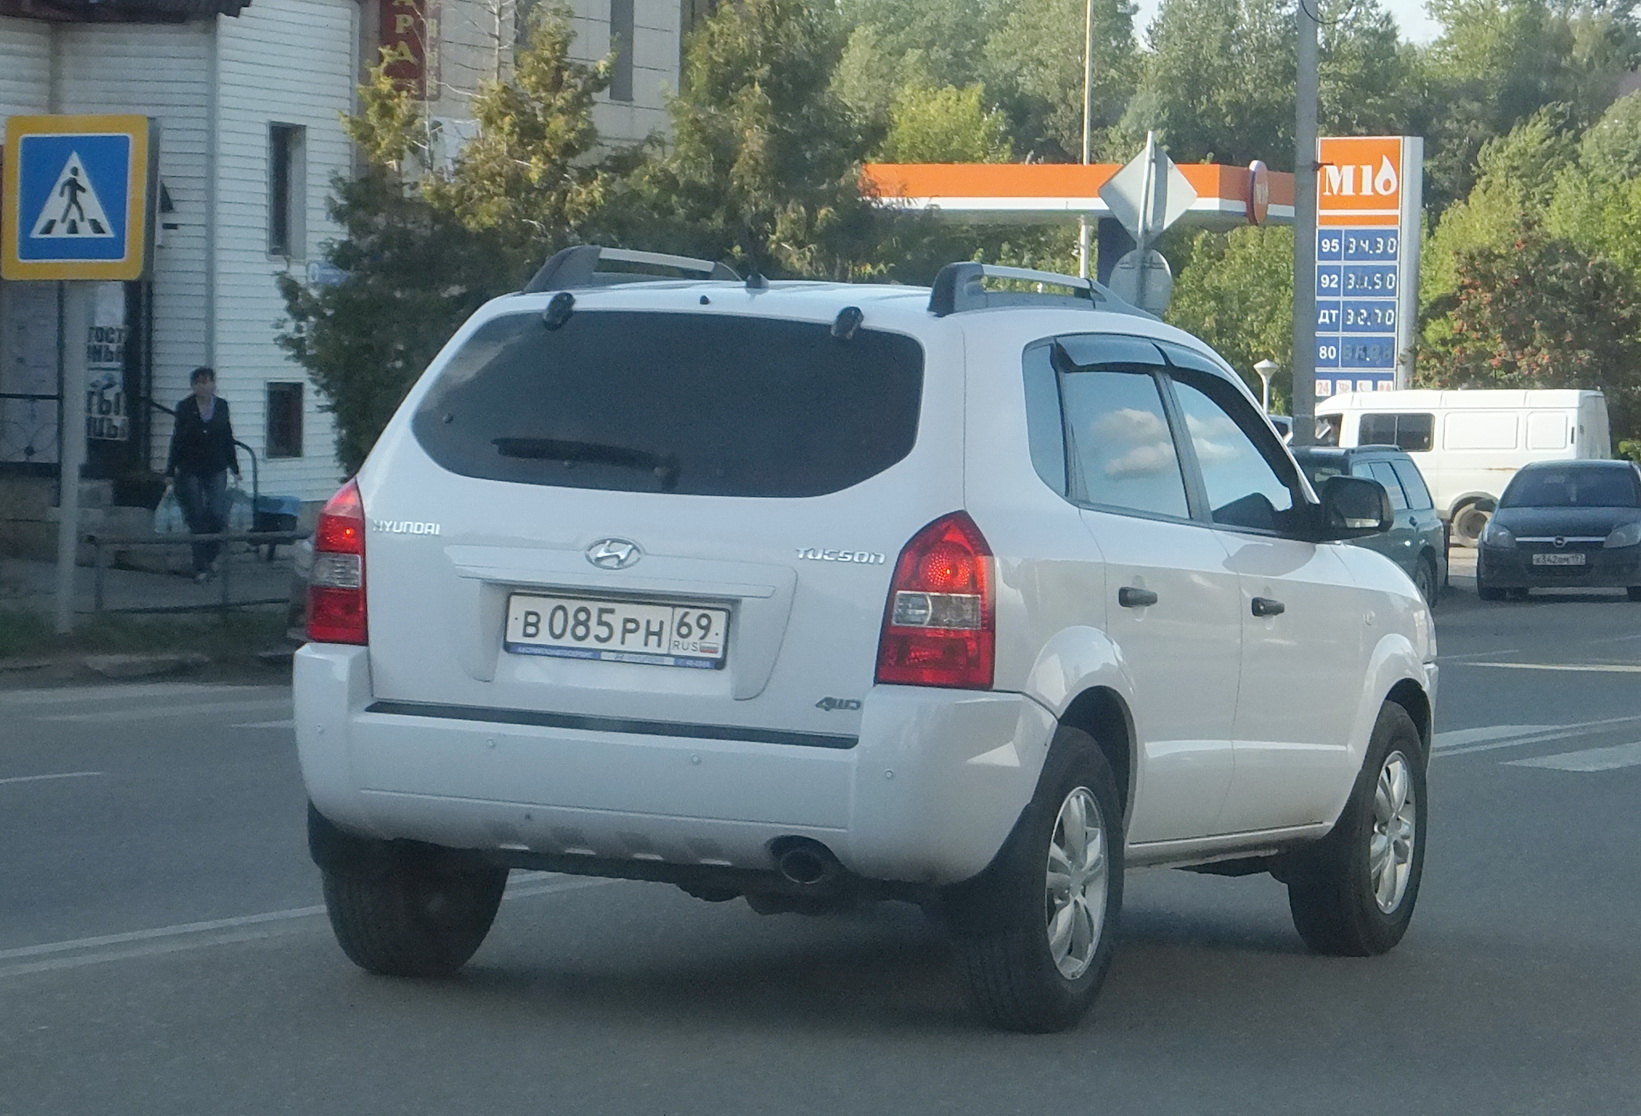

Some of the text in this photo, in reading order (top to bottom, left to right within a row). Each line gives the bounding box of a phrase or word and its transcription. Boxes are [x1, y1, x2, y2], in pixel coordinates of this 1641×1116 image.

[390, 0, 418, 63] РА
[1321, 237, 1397, 254] 95 34.30
[1320, 274, 1339, 288] 92
[1317, 310, 1339, 325] ДТ
[1319, 346, 1337, 360] 80
[372, 519, 441, 536] HYUNDAI
[522, 604, 712, 648] В085РН 69
[672, 639, 699, 652] RUS
[815, 696, 862, 711] 4WD
